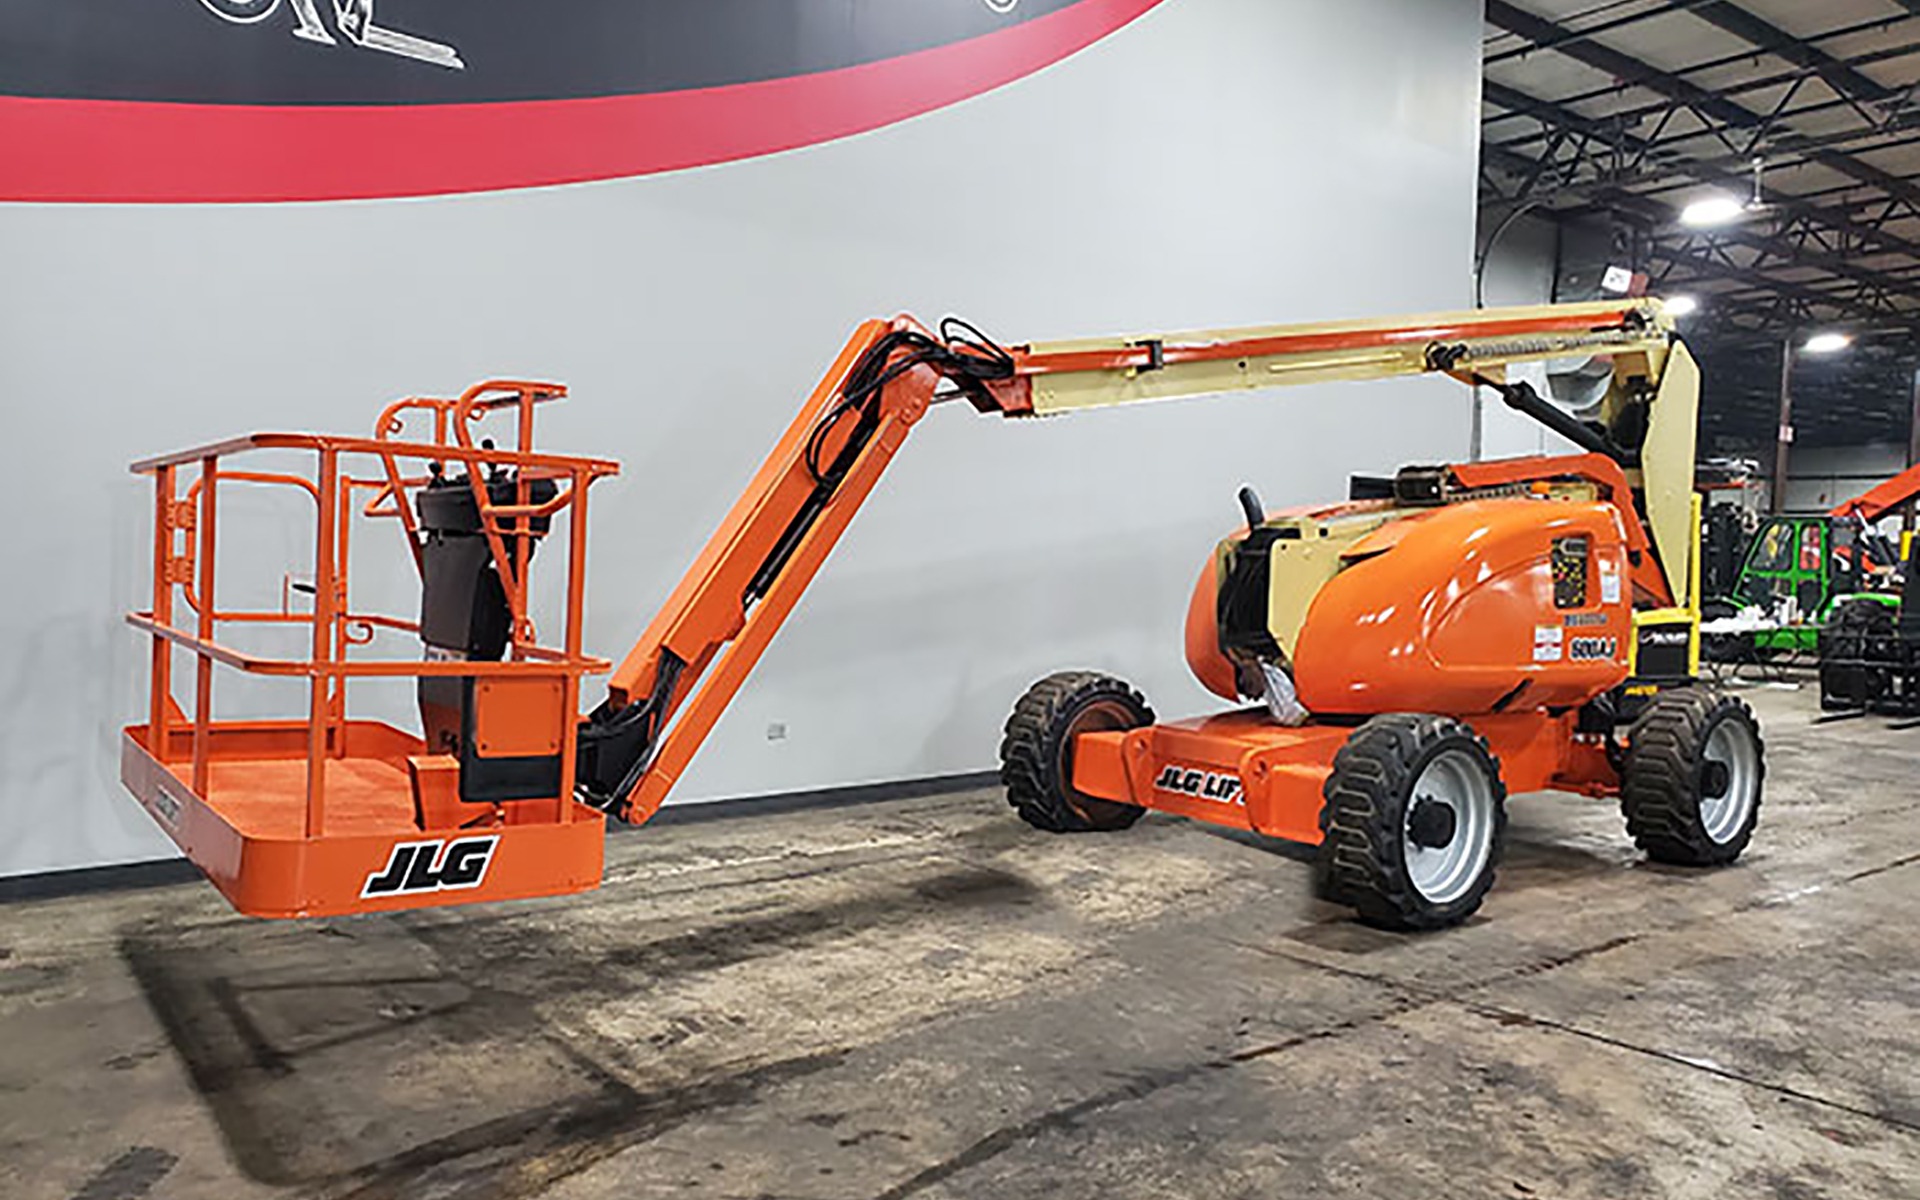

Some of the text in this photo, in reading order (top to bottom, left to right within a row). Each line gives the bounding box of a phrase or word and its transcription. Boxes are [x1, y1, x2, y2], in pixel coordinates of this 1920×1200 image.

[1154, 766, 1246, 803] JLG LIF
[362, 836, 499, 897] JLG
